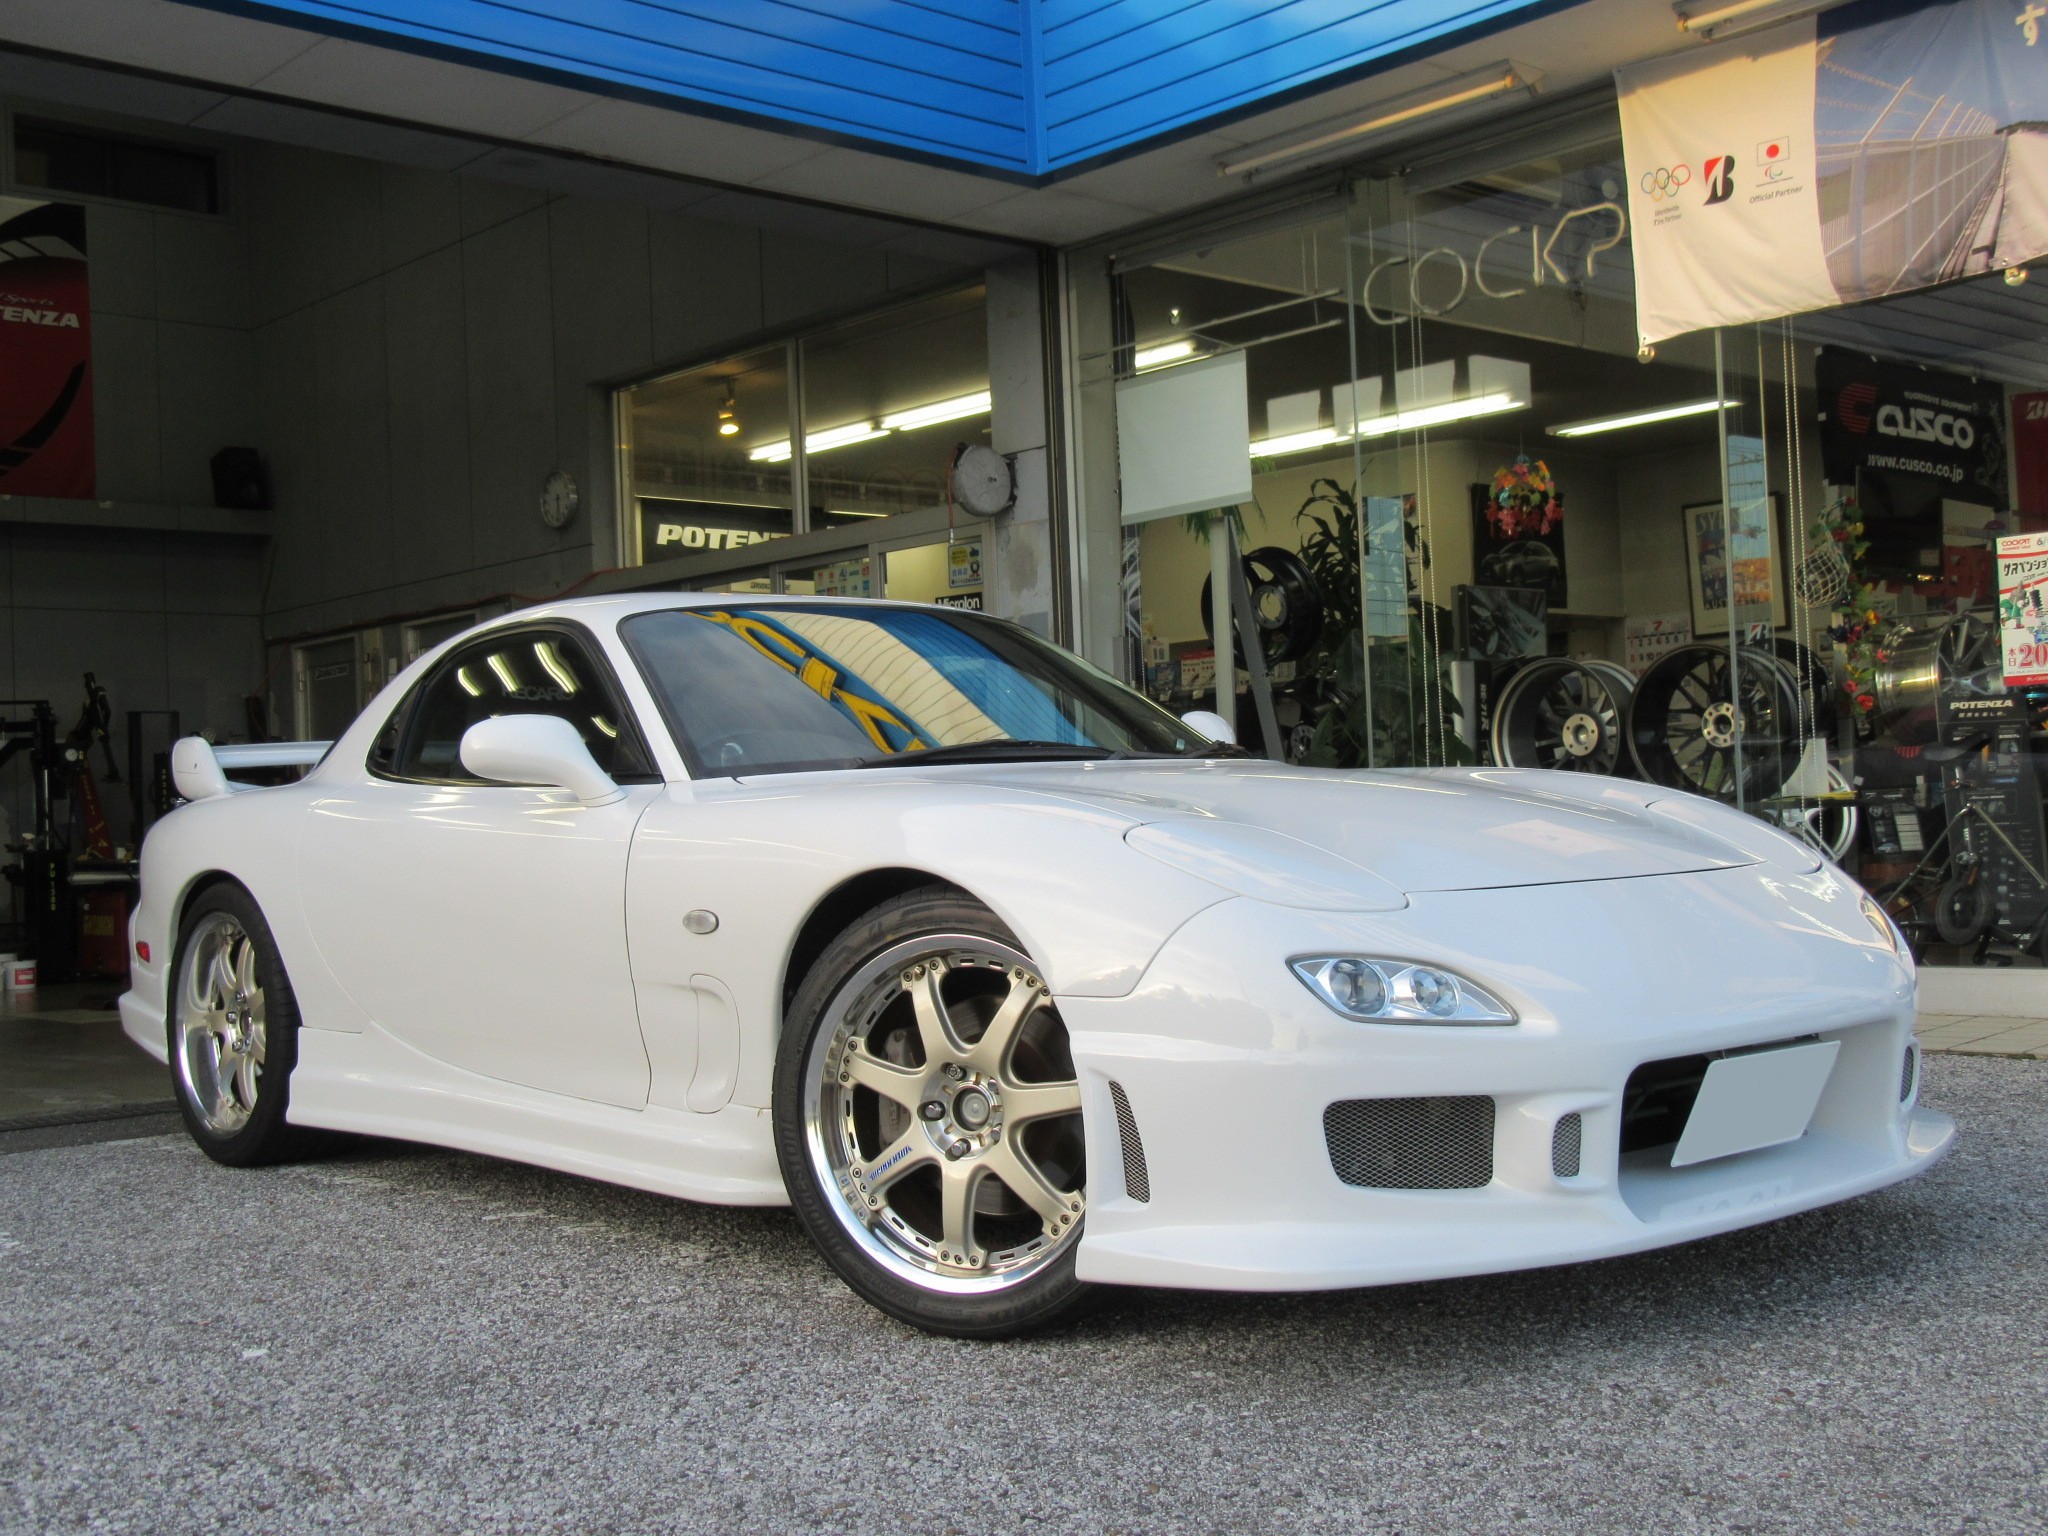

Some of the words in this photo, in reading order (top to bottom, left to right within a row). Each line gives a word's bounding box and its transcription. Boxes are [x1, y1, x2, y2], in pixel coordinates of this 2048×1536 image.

[1750, 192, 1774, 204] Official
[1775, 186, 1803, 198] Partner
[1876, 404, 1975, 450] CUSCO
[1867, 453, 1964, 484] www.cusco.co.jp
[656, 523, 792, 550] POTEN
[2002, 538, 2030, 547] COCKPIT
[1652, 621, 1663, 632] 7
[1950, 699, 2014, 710] POTENZA
